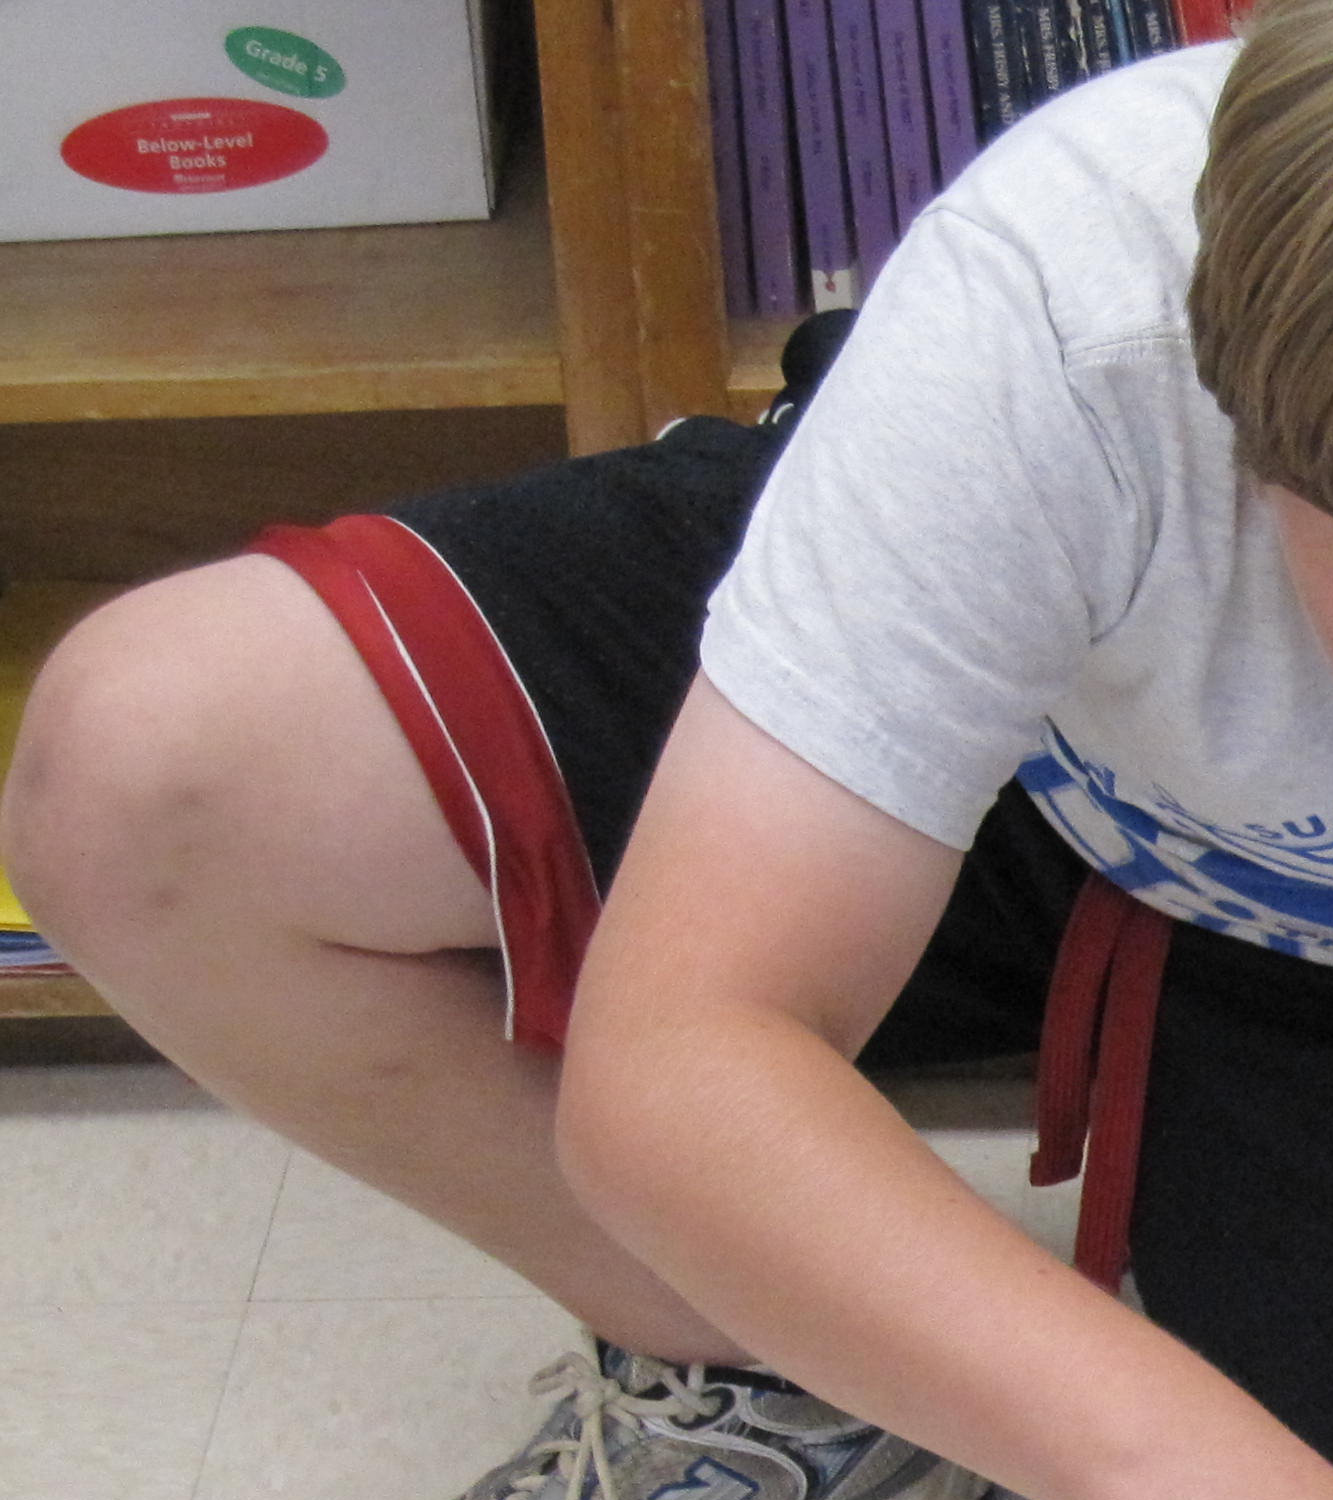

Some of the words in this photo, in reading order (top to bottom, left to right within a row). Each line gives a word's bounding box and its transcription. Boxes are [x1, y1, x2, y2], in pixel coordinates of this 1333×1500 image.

[245, 39, 308, 75] Grade
[313, 65, 328, 82] 5
[991, 42, 1010, 88] FRISBY
[1041, 43, 1060, 90] FRISBY
[136, 133, 253, 154] Below-Level
[169, 154, 227, 170] Books
